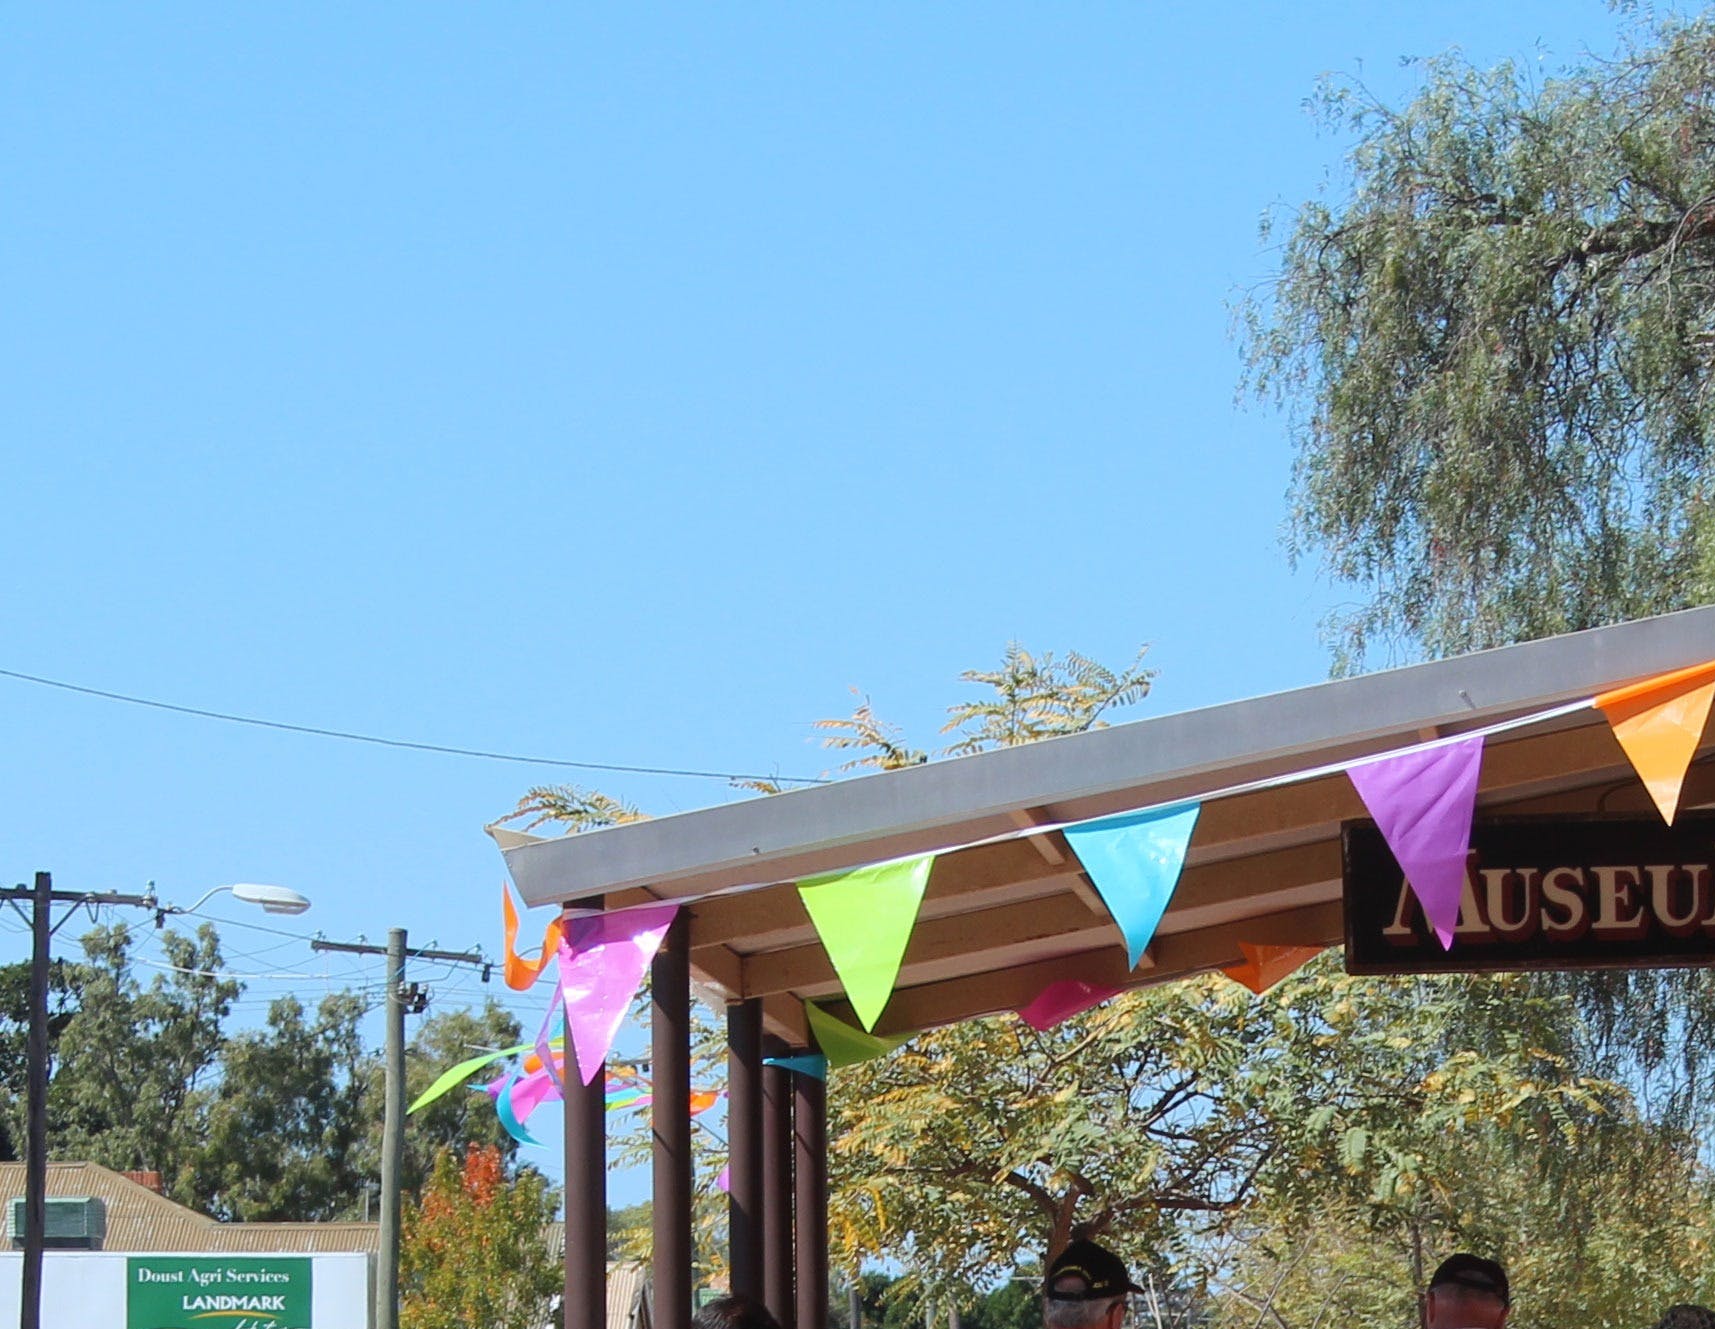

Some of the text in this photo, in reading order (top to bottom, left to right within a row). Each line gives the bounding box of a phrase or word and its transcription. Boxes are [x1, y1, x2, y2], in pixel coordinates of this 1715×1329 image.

[138, 1268, 289, 1287] Doust Agri Services
[182, 1295, 285, 1310] LANDMARK
